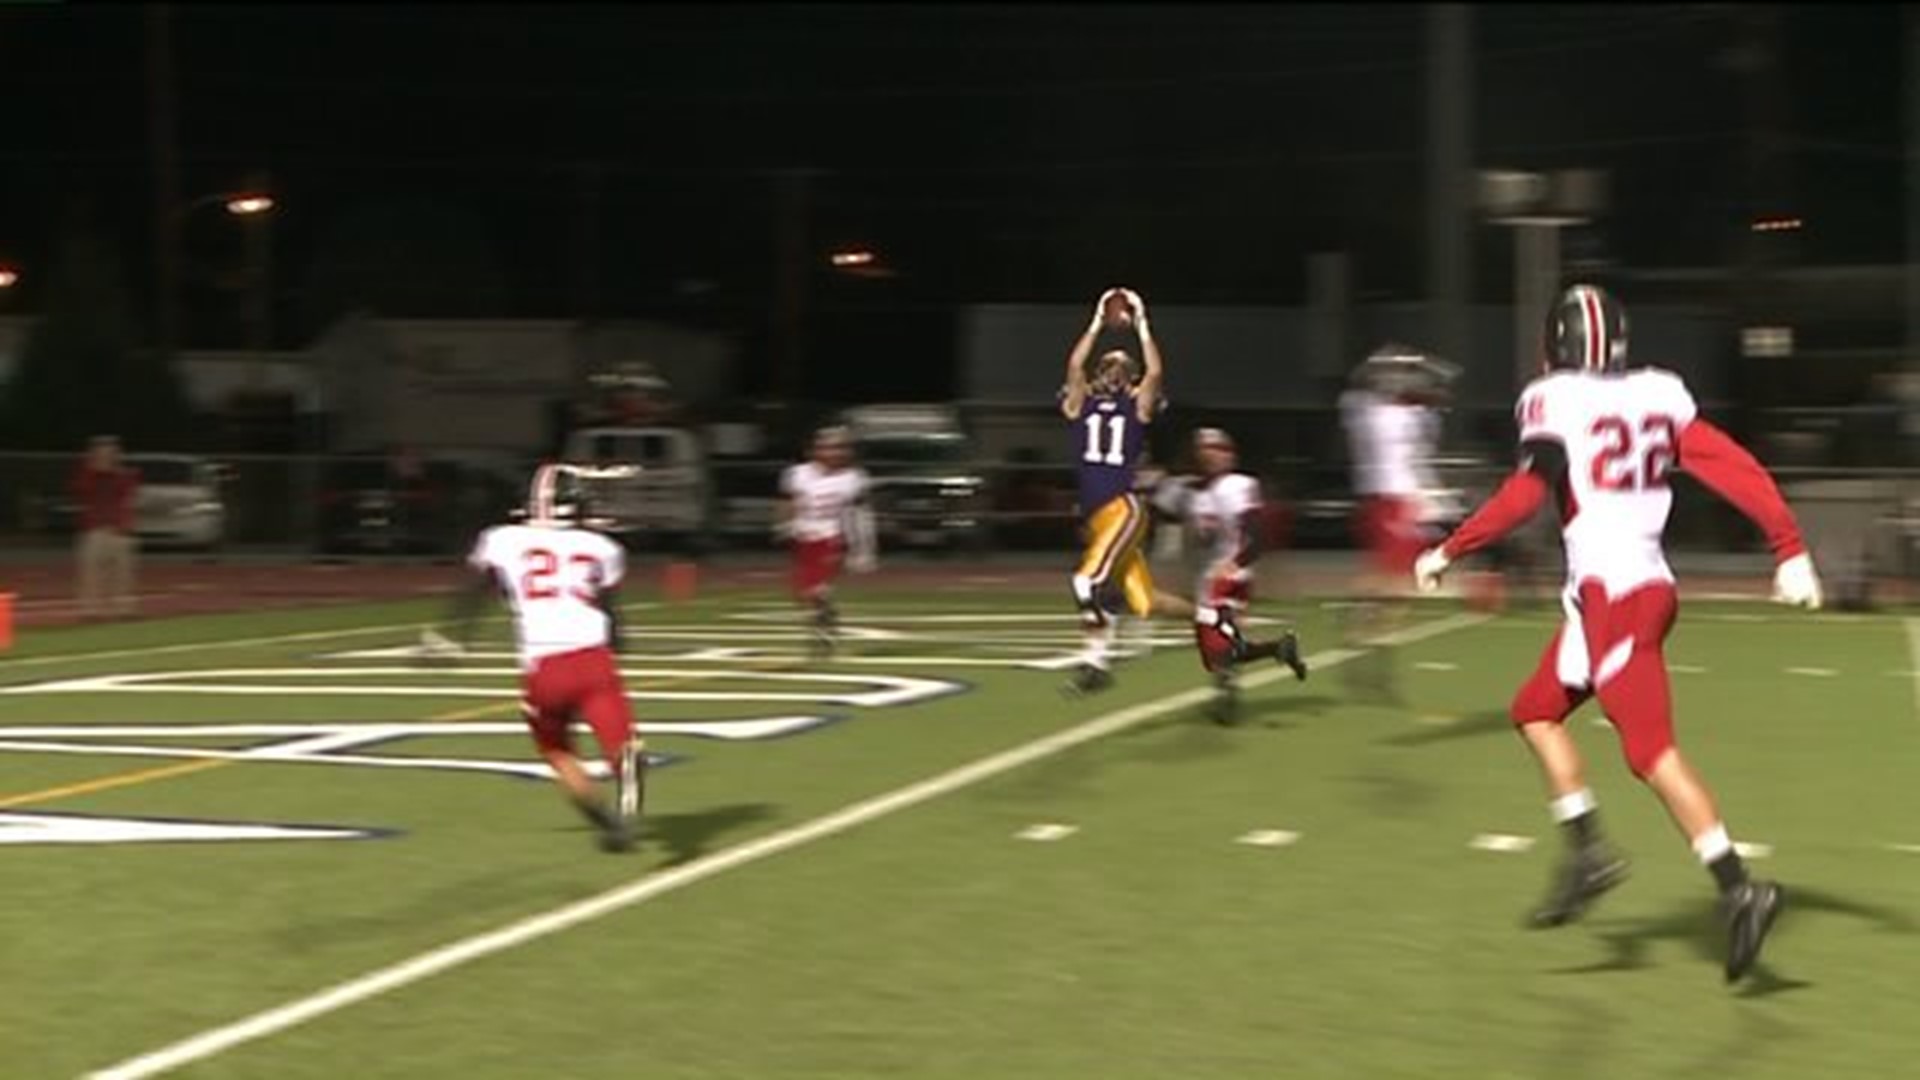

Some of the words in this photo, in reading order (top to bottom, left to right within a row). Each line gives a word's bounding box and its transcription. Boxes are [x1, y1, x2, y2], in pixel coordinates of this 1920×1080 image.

[1084, 413, 1125, 465] 11
[1590, 414, 1679, 491] 22
[521, 548, 604, 607] 23
